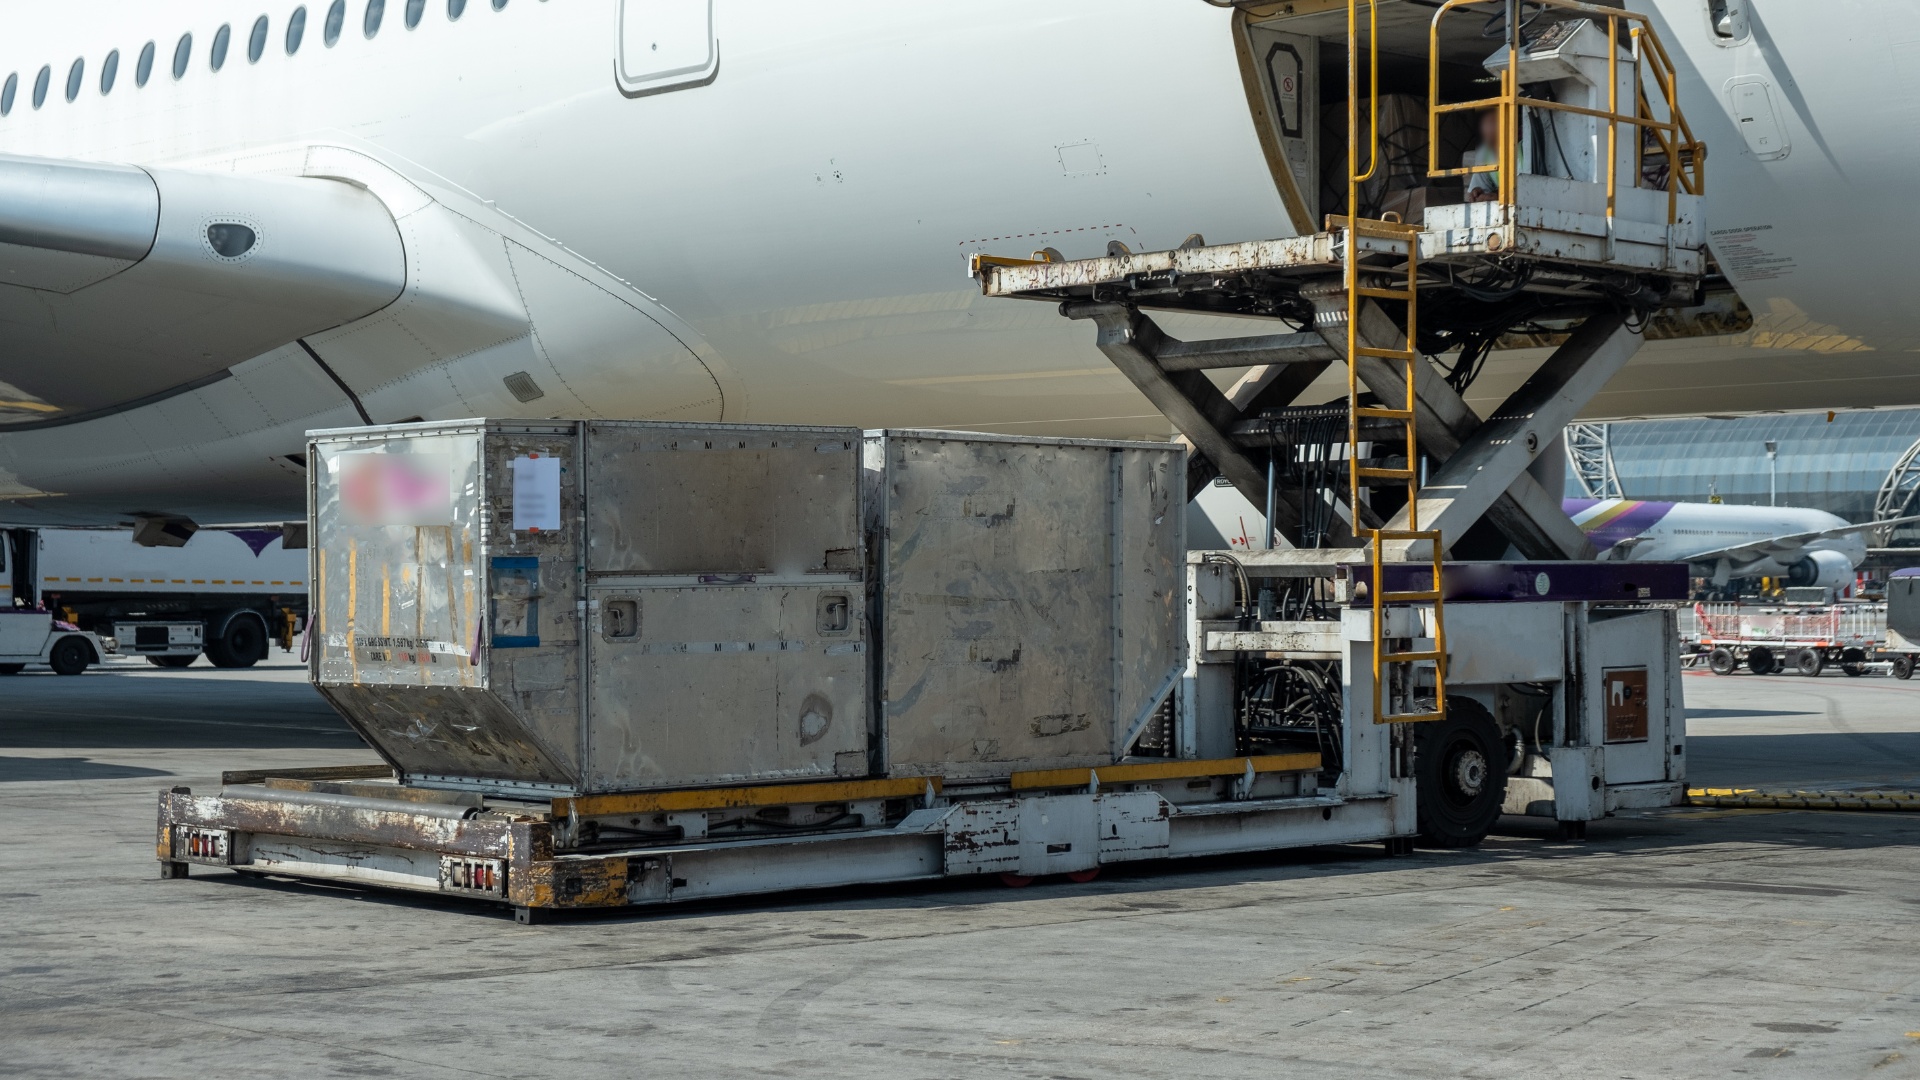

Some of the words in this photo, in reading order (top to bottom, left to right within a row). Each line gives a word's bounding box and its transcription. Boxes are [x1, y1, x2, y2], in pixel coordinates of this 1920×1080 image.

[705, 441, 712, 450] M
[739, 441, 746, 449] M
[771, 440, 778, 449] M
[844, 441, 851, 450] M
[439, 643, 446, 652] M
[714, 643, 722, 652] M
[748, 643, 755, 652] M
[780, 642, 787, 651] M
[853, 643, 861, 653] M
